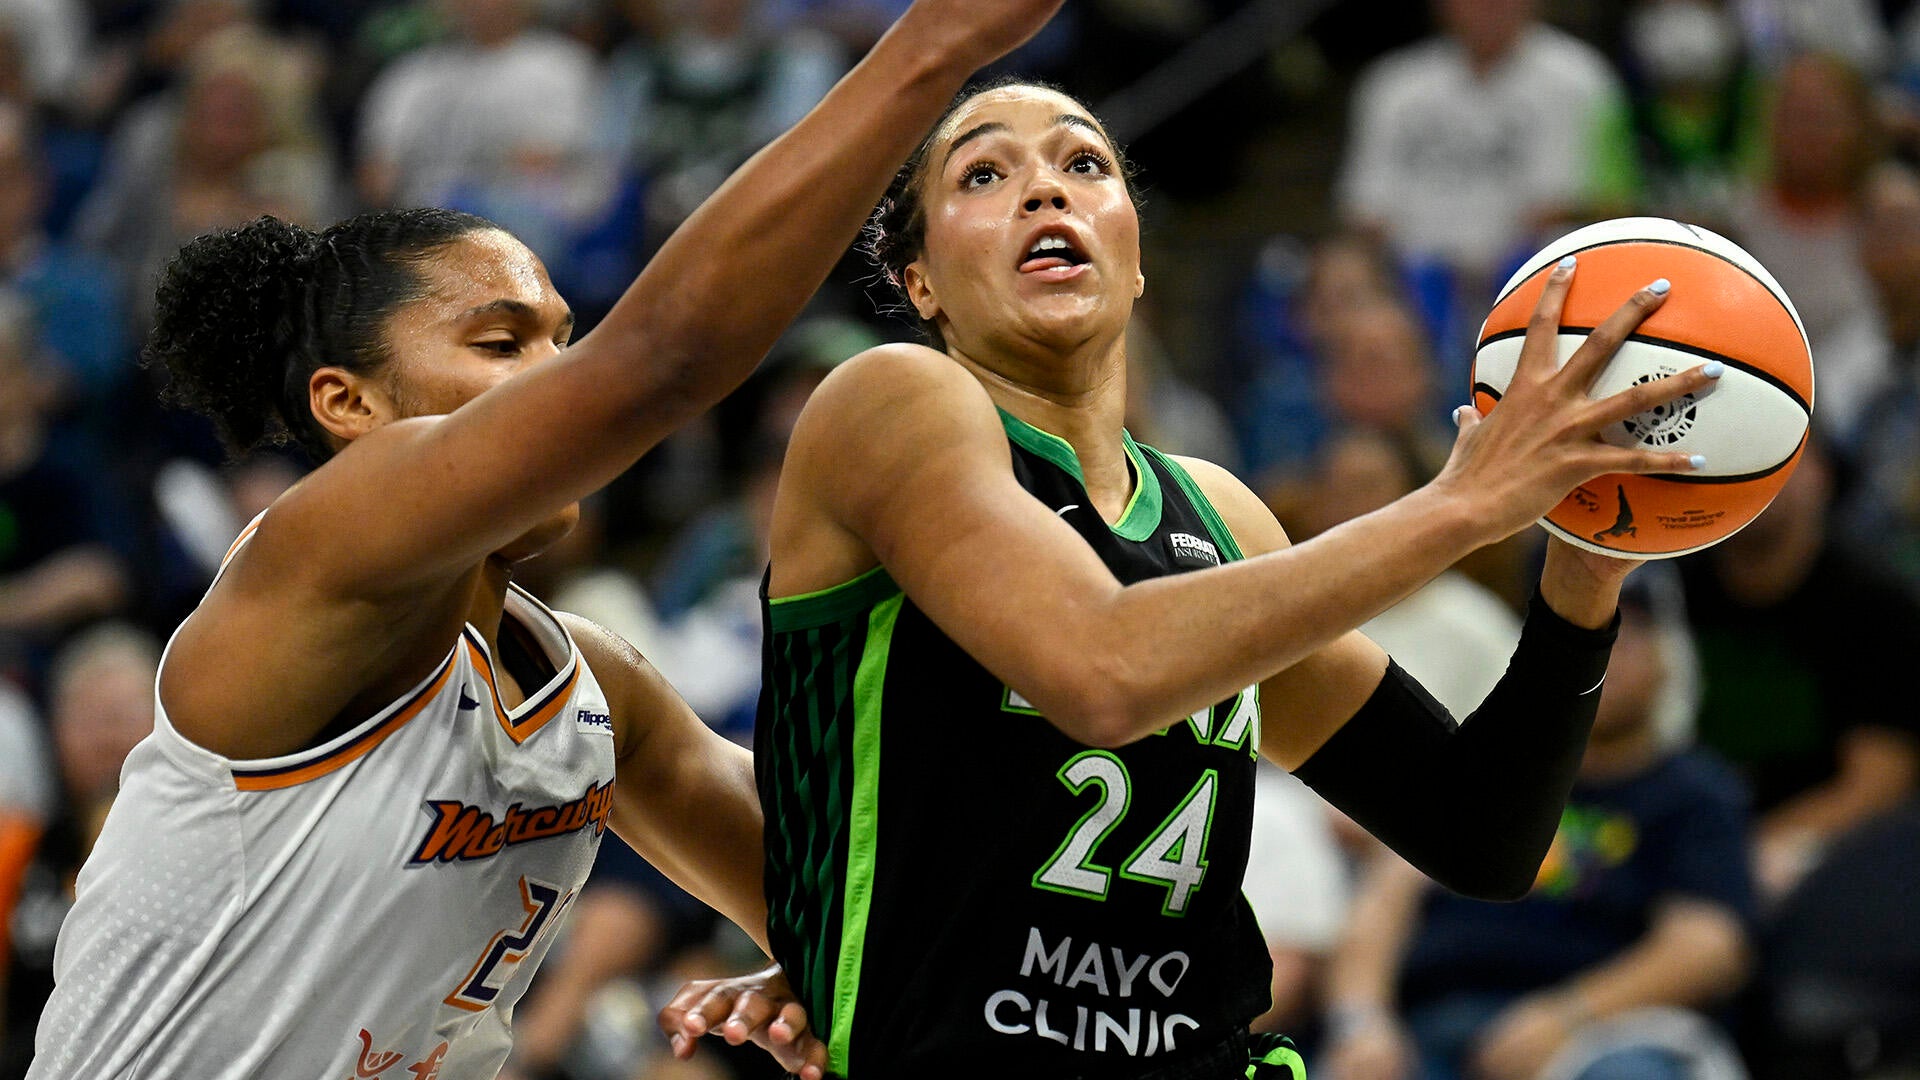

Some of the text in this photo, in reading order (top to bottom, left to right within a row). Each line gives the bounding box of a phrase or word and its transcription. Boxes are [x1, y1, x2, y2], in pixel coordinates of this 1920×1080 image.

[577, 710, 611, 726] Flippe
[407, 777, 614, 864] Mercury
[1031, 749, 1217, 917] 24
[1019, 926, 1190, 998] MAYO
